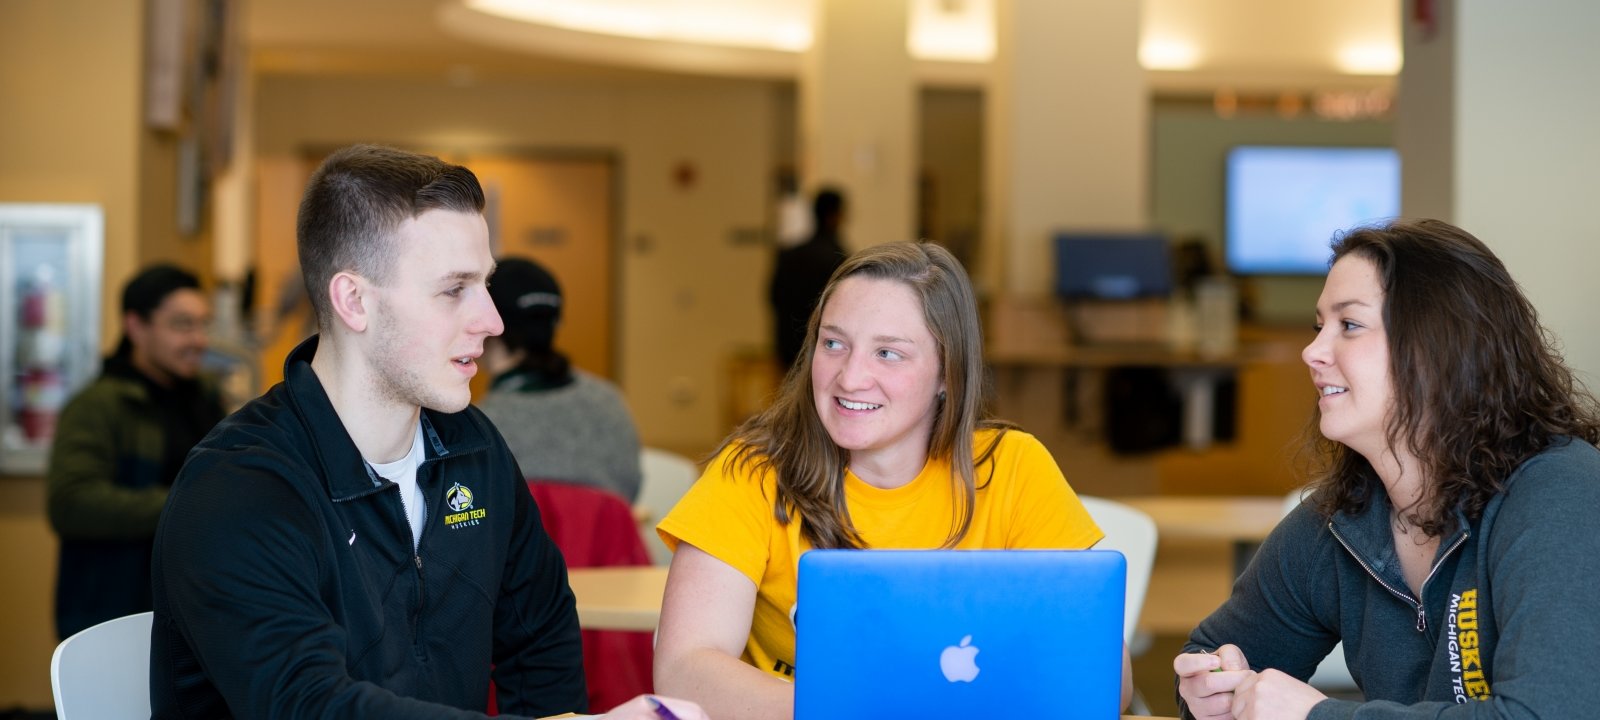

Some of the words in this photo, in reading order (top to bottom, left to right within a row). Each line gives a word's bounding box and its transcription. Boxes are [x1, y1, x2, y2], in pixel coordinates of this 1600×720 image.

[451, 519, 480, 529] HUSKIES
[469, 508, 486, 520] TECH
[1448, 593, 1461, 672] MICHIGAN
[1452, 676, 1467, 705] TEC
